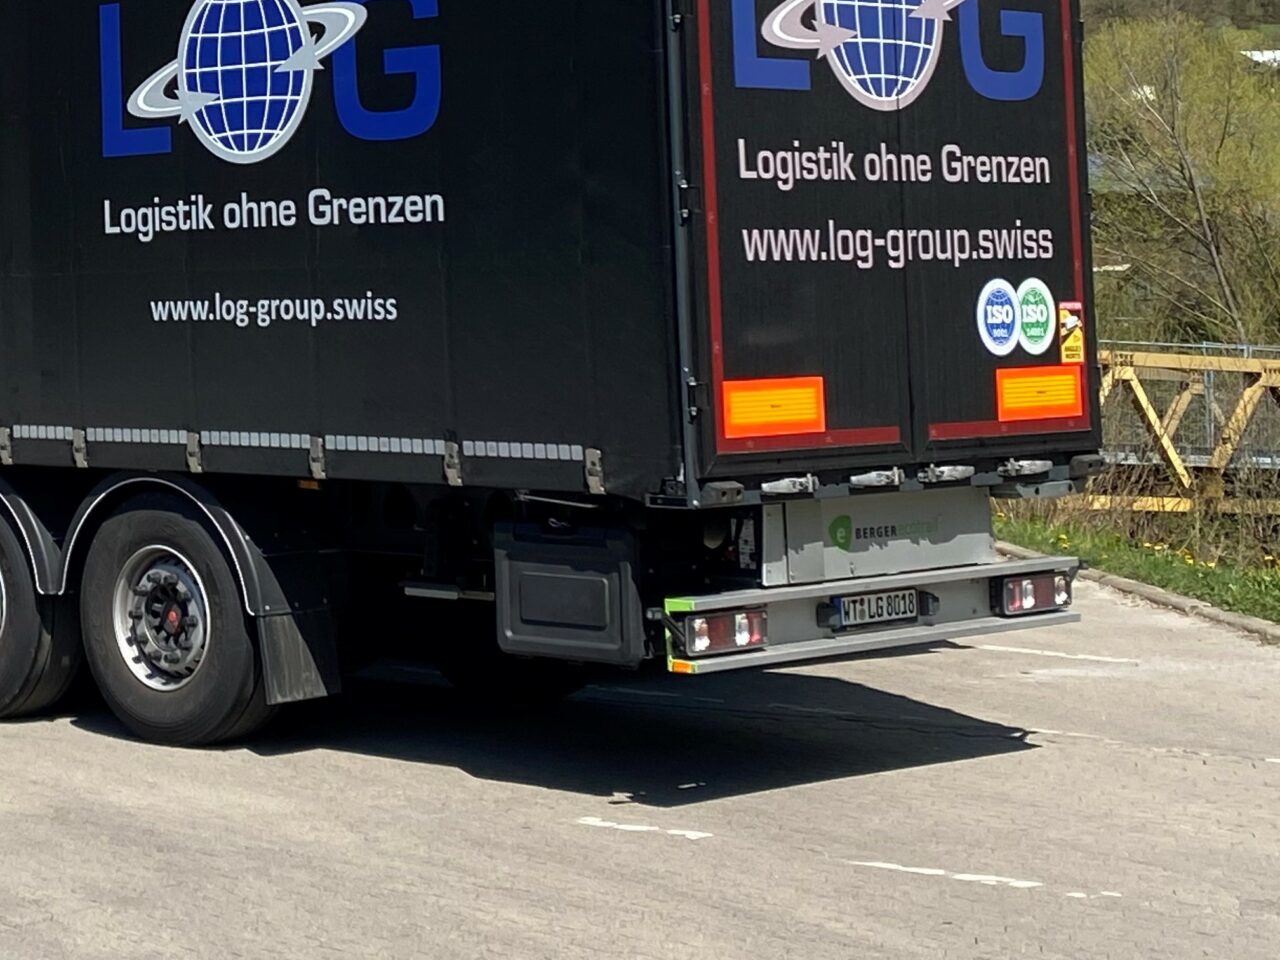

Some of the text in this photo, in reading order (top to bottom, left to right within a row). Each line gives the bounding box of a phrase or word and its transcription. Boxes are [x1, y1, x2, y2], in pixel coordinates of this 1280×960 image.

[737, 138, 1051, 191] Logistik ohne Grenzen
[103, 188, 445, 243] Logistik ohne Grenzen
[741, 219, 1054, 269] www.log-group.swiss
[150, 290, 398, 327] www.log-group.swiss
[985, 304, 1014, 324] ISO
[1021, 304, 1048, 324] ISO
[868, 597, 884, 619] LG
[886, 592, 915, 617] 8018
